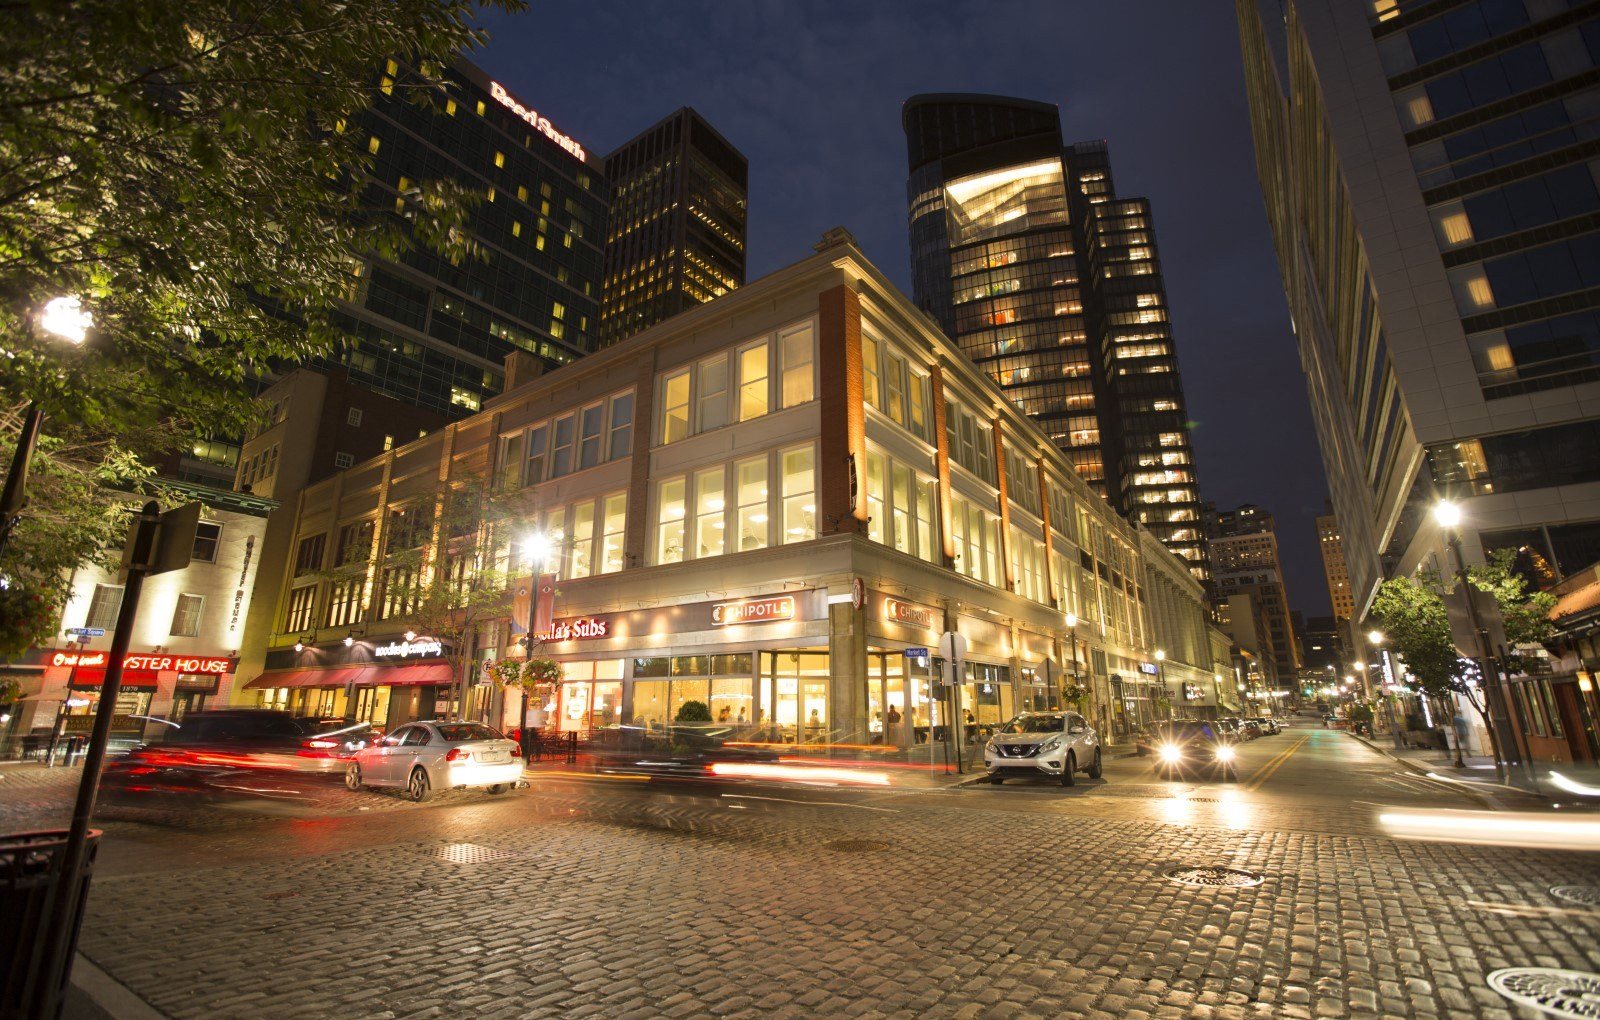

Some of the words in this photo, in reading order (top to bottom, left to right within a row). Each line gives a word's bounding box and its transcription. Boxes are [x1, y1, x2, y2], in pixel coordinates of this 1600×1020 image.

[727, 601, 789, 619] CHIPOTLE
[900, 606, 934, 624] CHIPOTLE
[573, 618, 606, 638] Subs
[122, 656, 171, 670] YSTER
[175, 659, 228, 673] HOUSE
